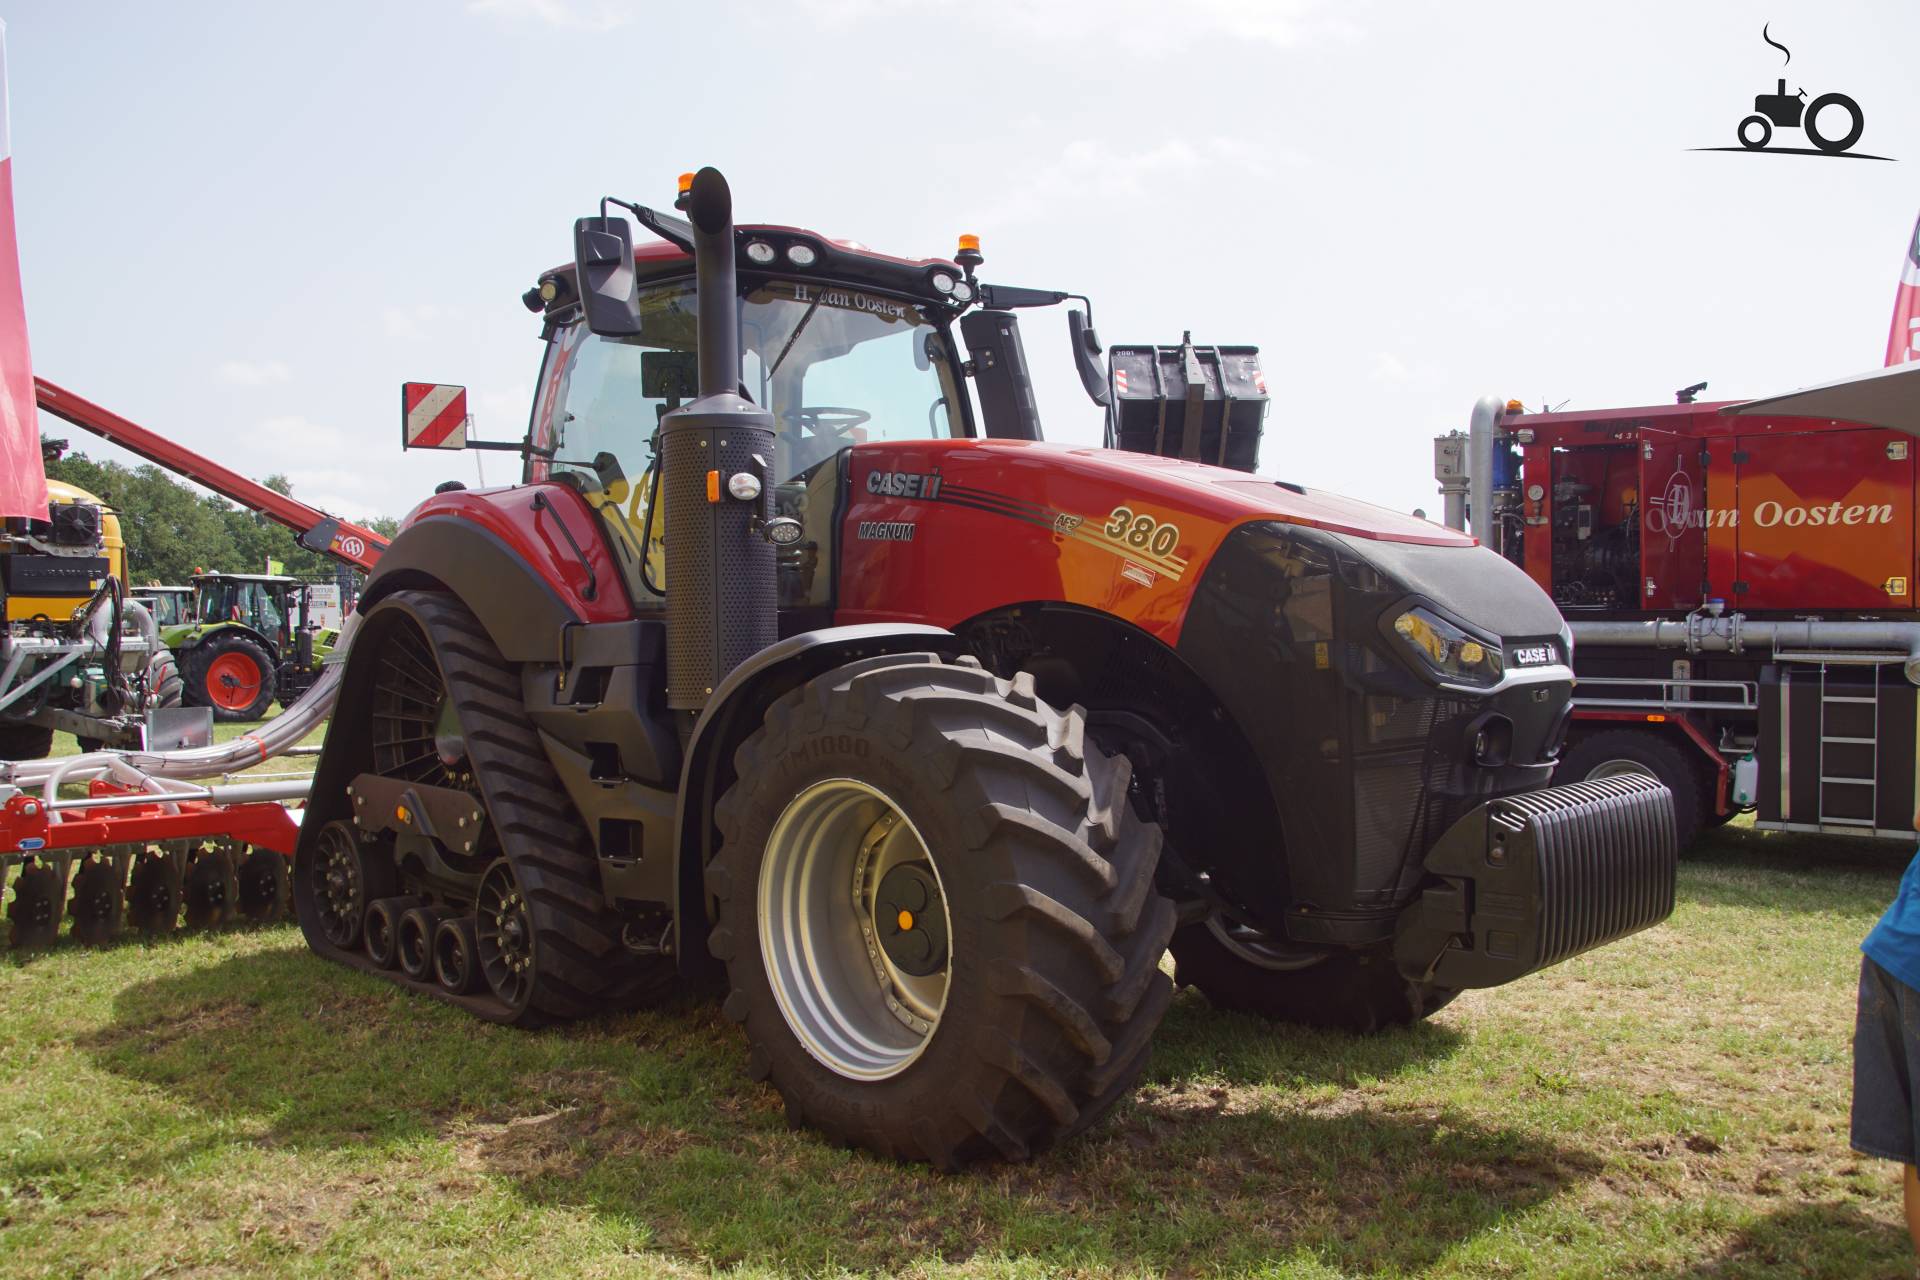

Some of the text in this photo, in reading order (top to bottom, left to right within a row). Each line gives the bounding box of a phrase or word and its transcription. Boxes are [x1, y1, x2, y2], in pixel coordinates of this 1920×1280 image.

[794, 285, 813, 301] H.
[854, 292, 906, 318] Oosten
[866, 470, 921, 498] CASE
[1753, 501, 1893, 528] Oosten
[858, 521, 915, 542] MAGNUM
[1104, 506, 1179, 559] 380
[1517, 648, 1547, 664] CASE
